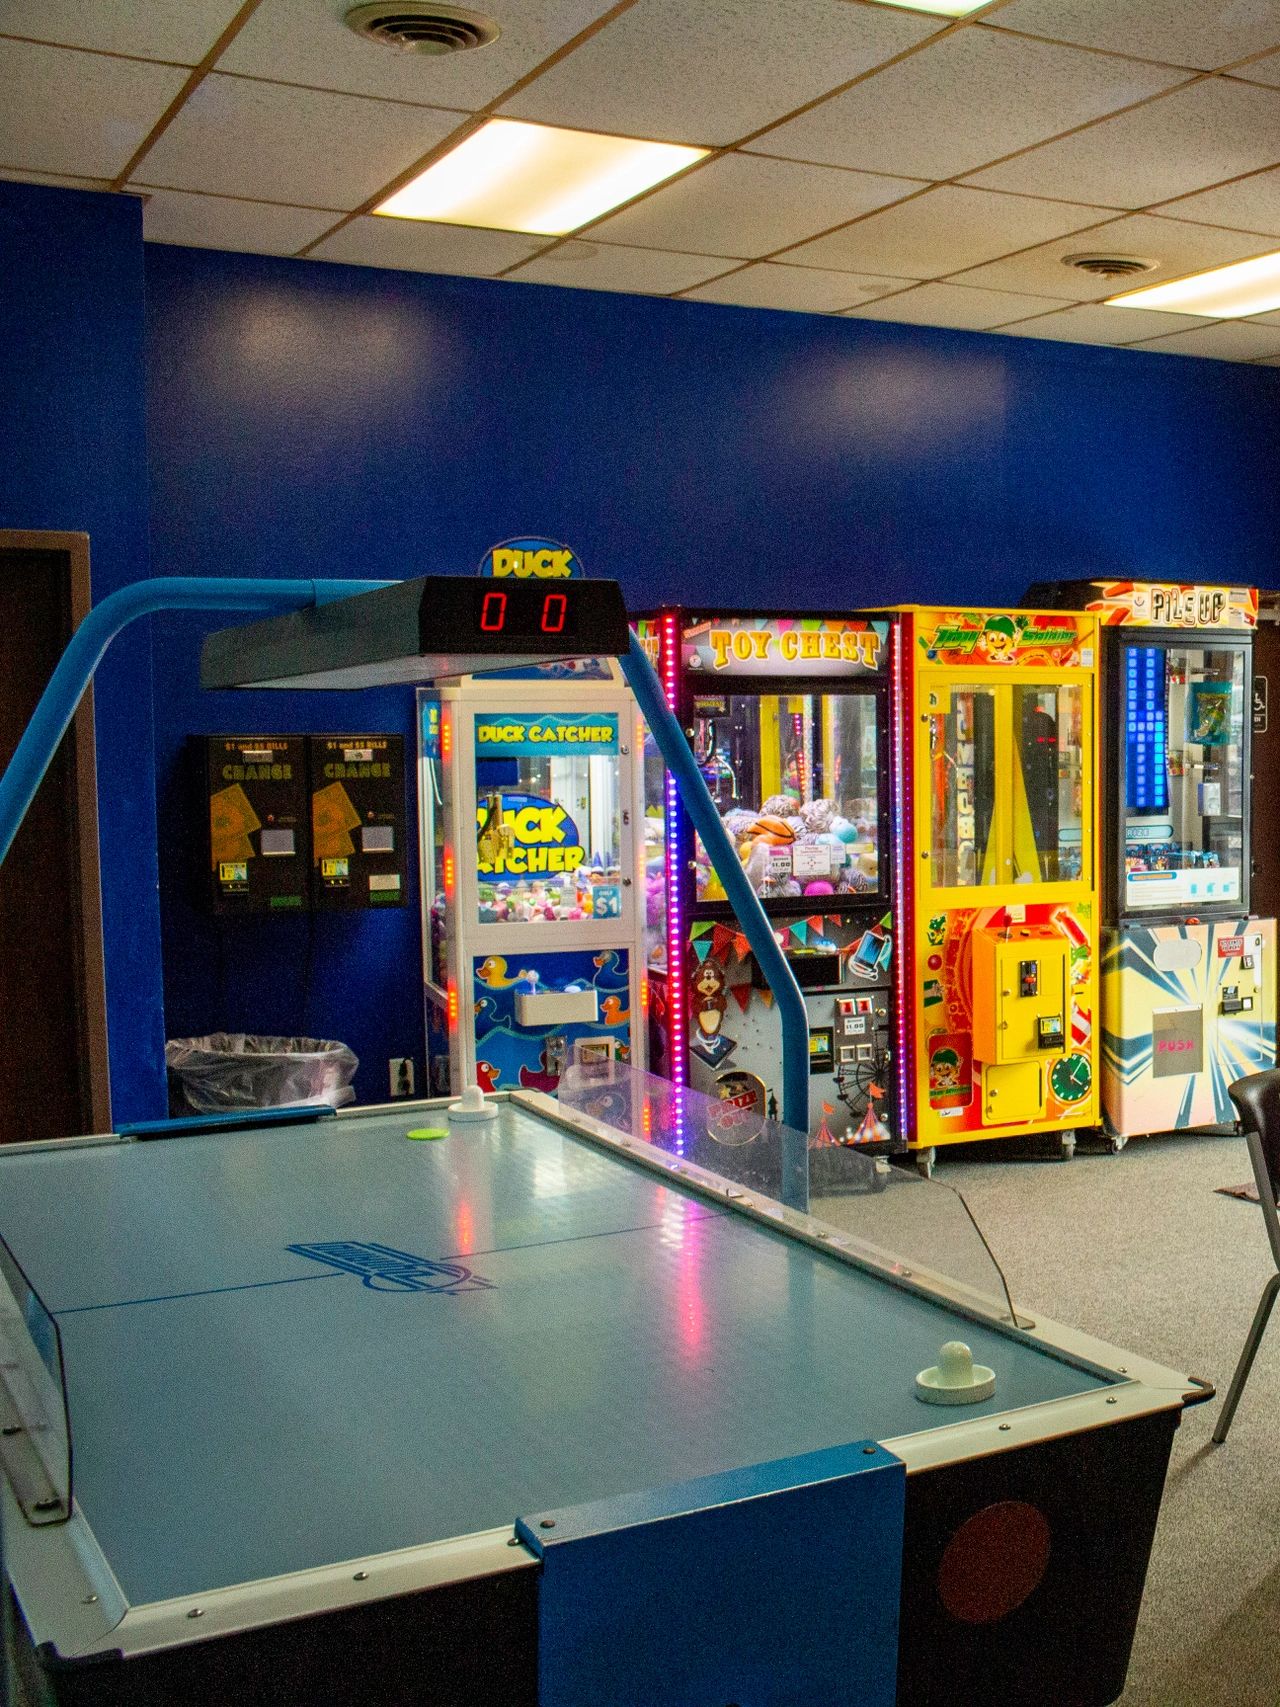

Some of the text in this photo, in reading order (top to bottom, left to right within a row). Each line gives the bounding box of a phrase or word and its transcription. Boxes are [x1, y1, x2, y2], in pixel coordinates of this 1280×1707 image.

[492, 549, 573, 578] DUCK
[481, 592, 567, 632] 0 0
[1151, 588, 1225, 625] PILE UP
[932, 625, 981, 655] Toy
[709, 630, 773, 669] TOY
[780, 630, 882, 670] CHEST
[479, 725, 613, 743] DUCK CATCHER
[222, 764, 292, 780] CHANGE
[324, 763, 391, 778] CHANGE
[1127, 828, 1149, 837] RIZE
[596, 896, 619, 914] $1
[1157, 1039, 1195, 1053] PUSH
